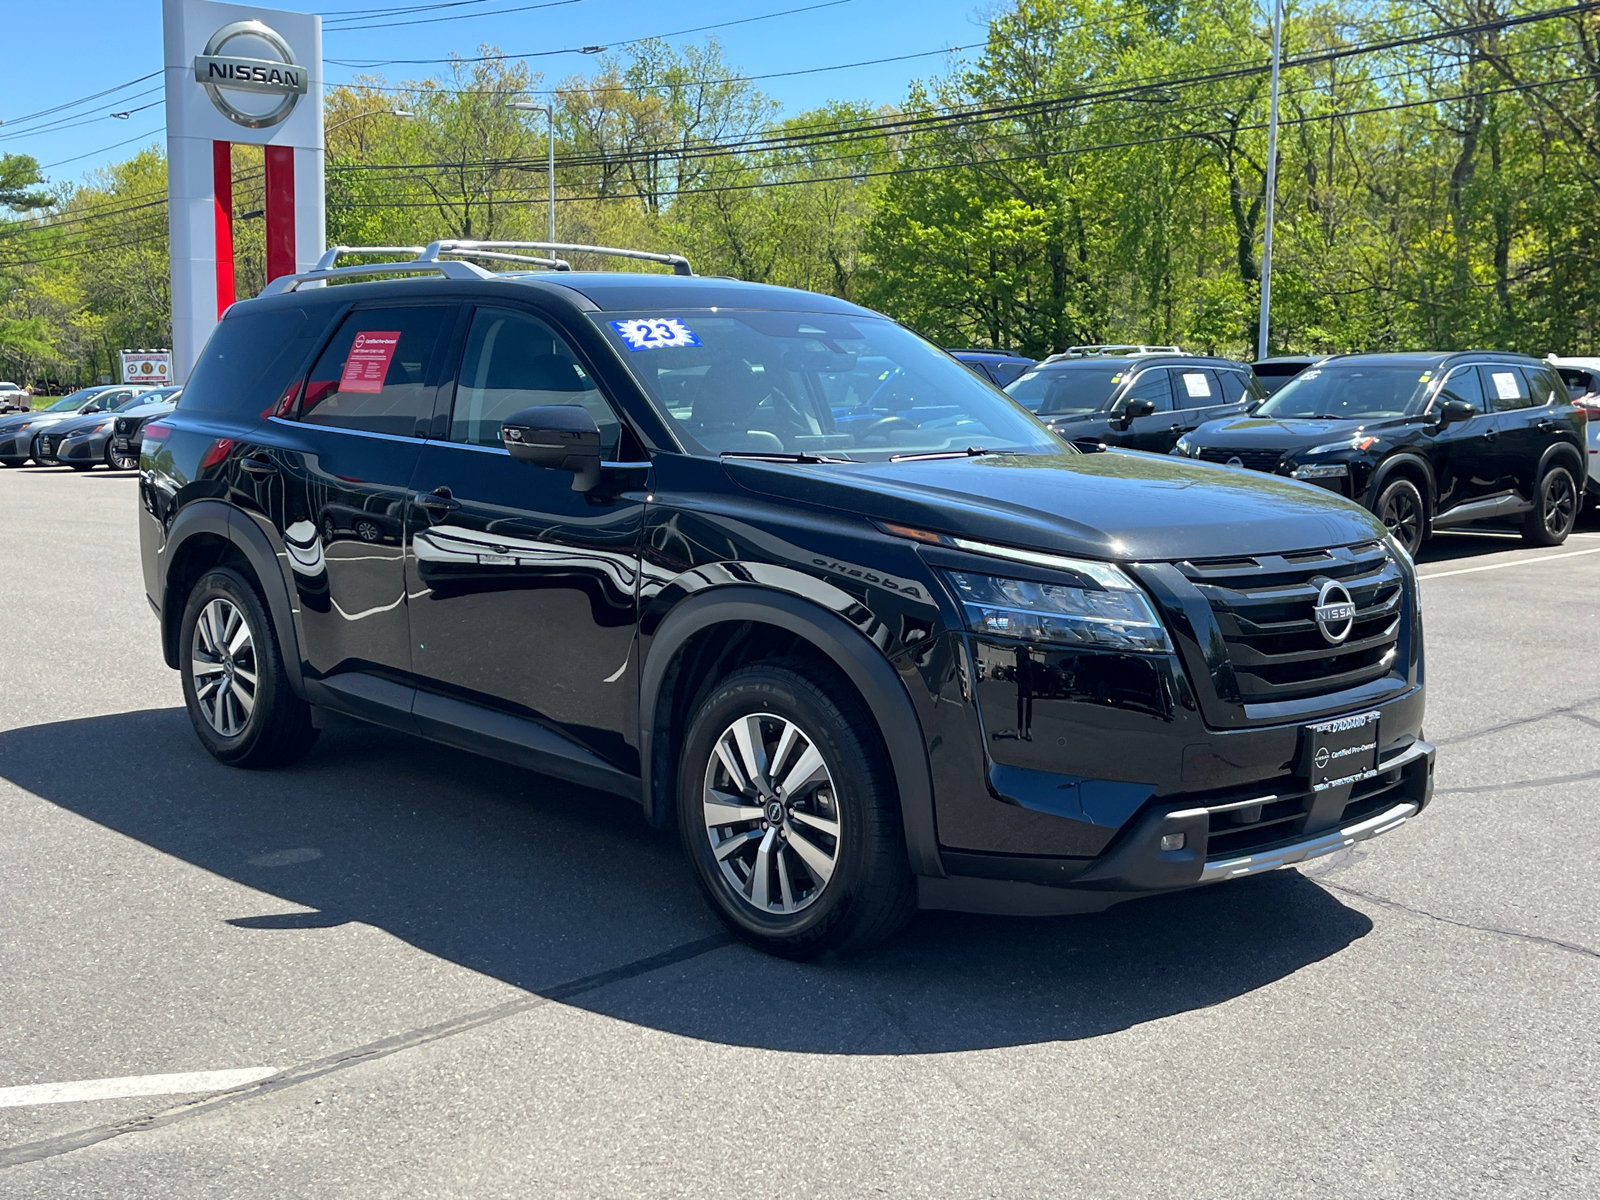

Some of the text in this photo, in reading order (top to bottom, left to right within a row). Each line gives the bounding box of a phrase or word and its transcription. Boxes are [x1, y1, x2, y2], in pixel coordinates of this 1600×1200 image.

[209, 62, 299, 87] NISSAN
[636, 323, 676, 342] 23
[1317, 607, 1356, 620] NISSAN
[1332, 748, 1352, 758] Certified
